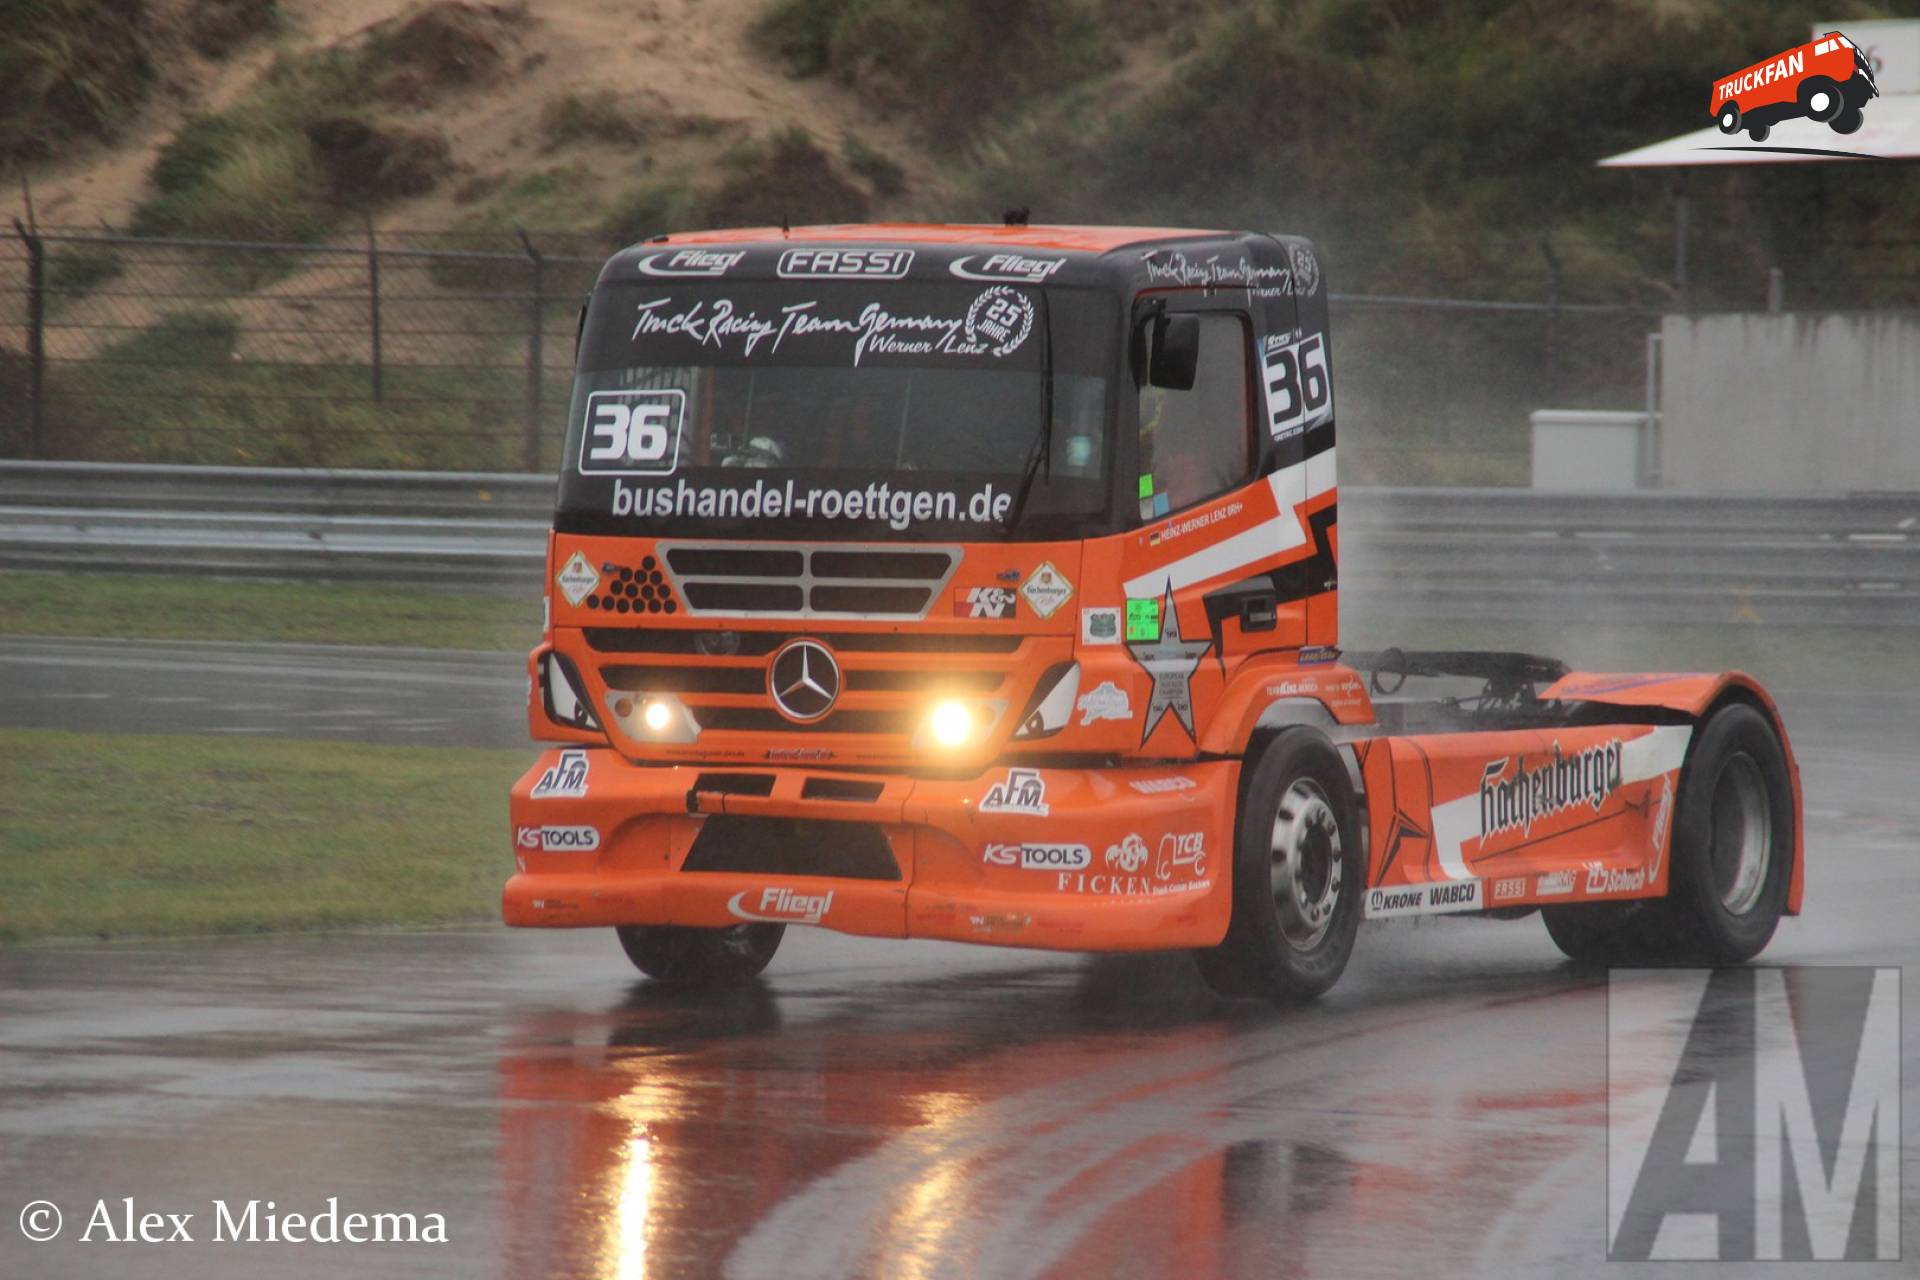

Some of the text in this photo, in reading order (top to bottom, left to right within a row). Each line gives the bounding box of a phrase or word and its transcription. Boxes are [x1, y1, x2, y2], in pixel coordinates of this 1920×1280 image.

[662, 250, 746, 276] Fliegl
[786, 250, 905, 274] FASSI
[978, 255, 1067, 282] Fliegl
[985, 298, 1022, 327] 25
[632, 298, 963, 368] Truck Racing Team Germany
[977, 318, 1011, 342] JAHRE
[868, 334, 989, 354] Werner Lenz
[1265, 337, 1328, 425] 36
[589, 403, 671, 460] 36
[611, 479, 1012, 530] bushandel-roettgen.de
[966, 587, 1016, 618] K&N
[535, 753, 587, 792] AFM
[983, 770, 1042, 807] AFM
[517, 827, 594, 848] KS TOOLS
[1176, 832, 1204, 856] TCB
[983, 843, 1084, 865] KS TOOLS
[1057, 872, 1151, 896] FICKEN
[1383, 883, 1475, 910] KRONE WABCO
[755, 887, 834, 922] Fliegl
